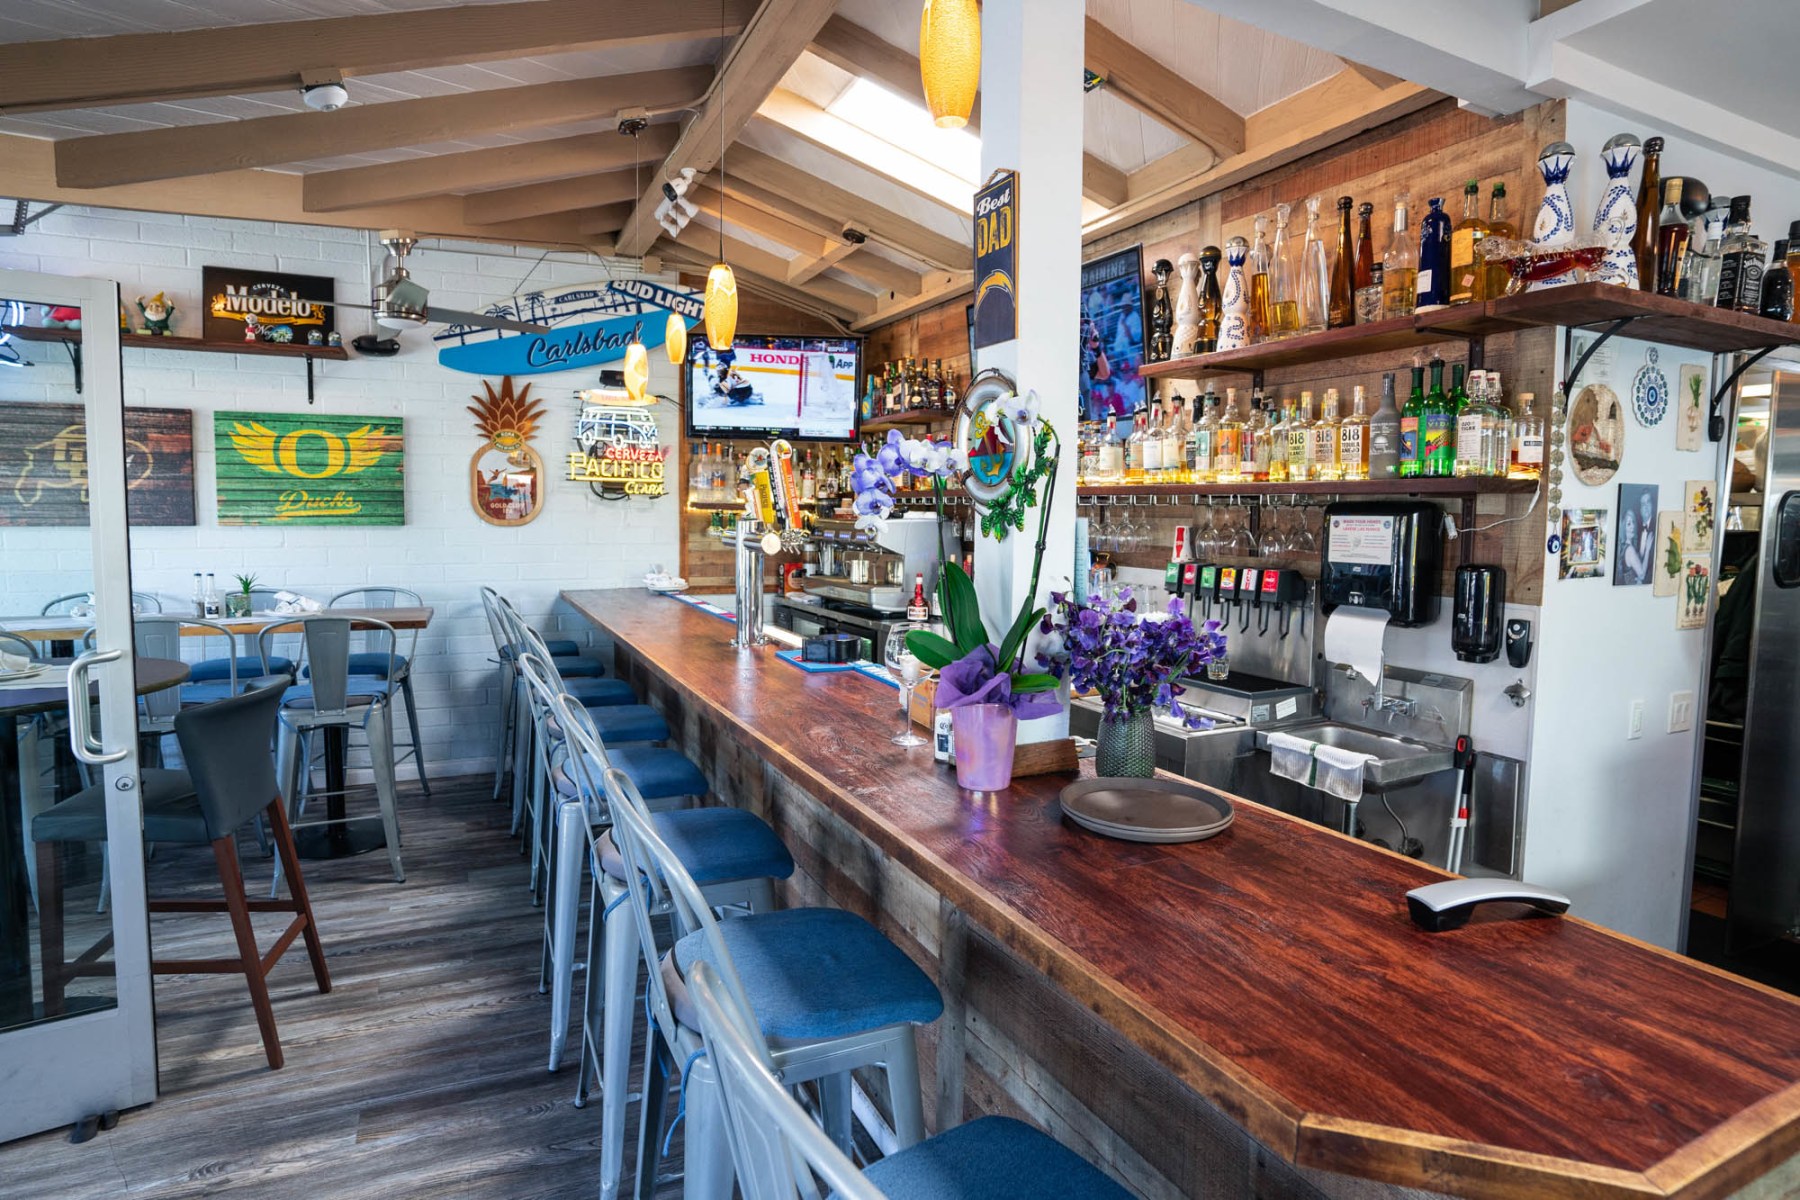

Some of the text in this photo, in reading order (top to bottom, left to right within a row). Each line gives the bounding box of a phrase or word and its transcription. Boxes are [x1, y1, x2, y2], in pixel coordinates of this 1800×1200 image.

[976, 188, 1011, 217] Best
[977, 206, 1012, 258] DAD
[252, 283, 285, 293] CERVEZA
[612, 280, 654, 299] BUD
[225, 284, 311, 317] Modelo
[558, 291, 595, 303] CARLSBAD
[526, 320, 644, 368] Carlsbad
[1289, 432, 1305, 445] 818
[1315, 430, 1332, 443] 818
[1341, 428, 1360, 441] 818
[605, 447, 664, 462] CERVEZA
[569, 451, 664, 480] PACIFICO
[624, 481, 664, 495] CLARA
[276, 490, 357, 512] Ducks
